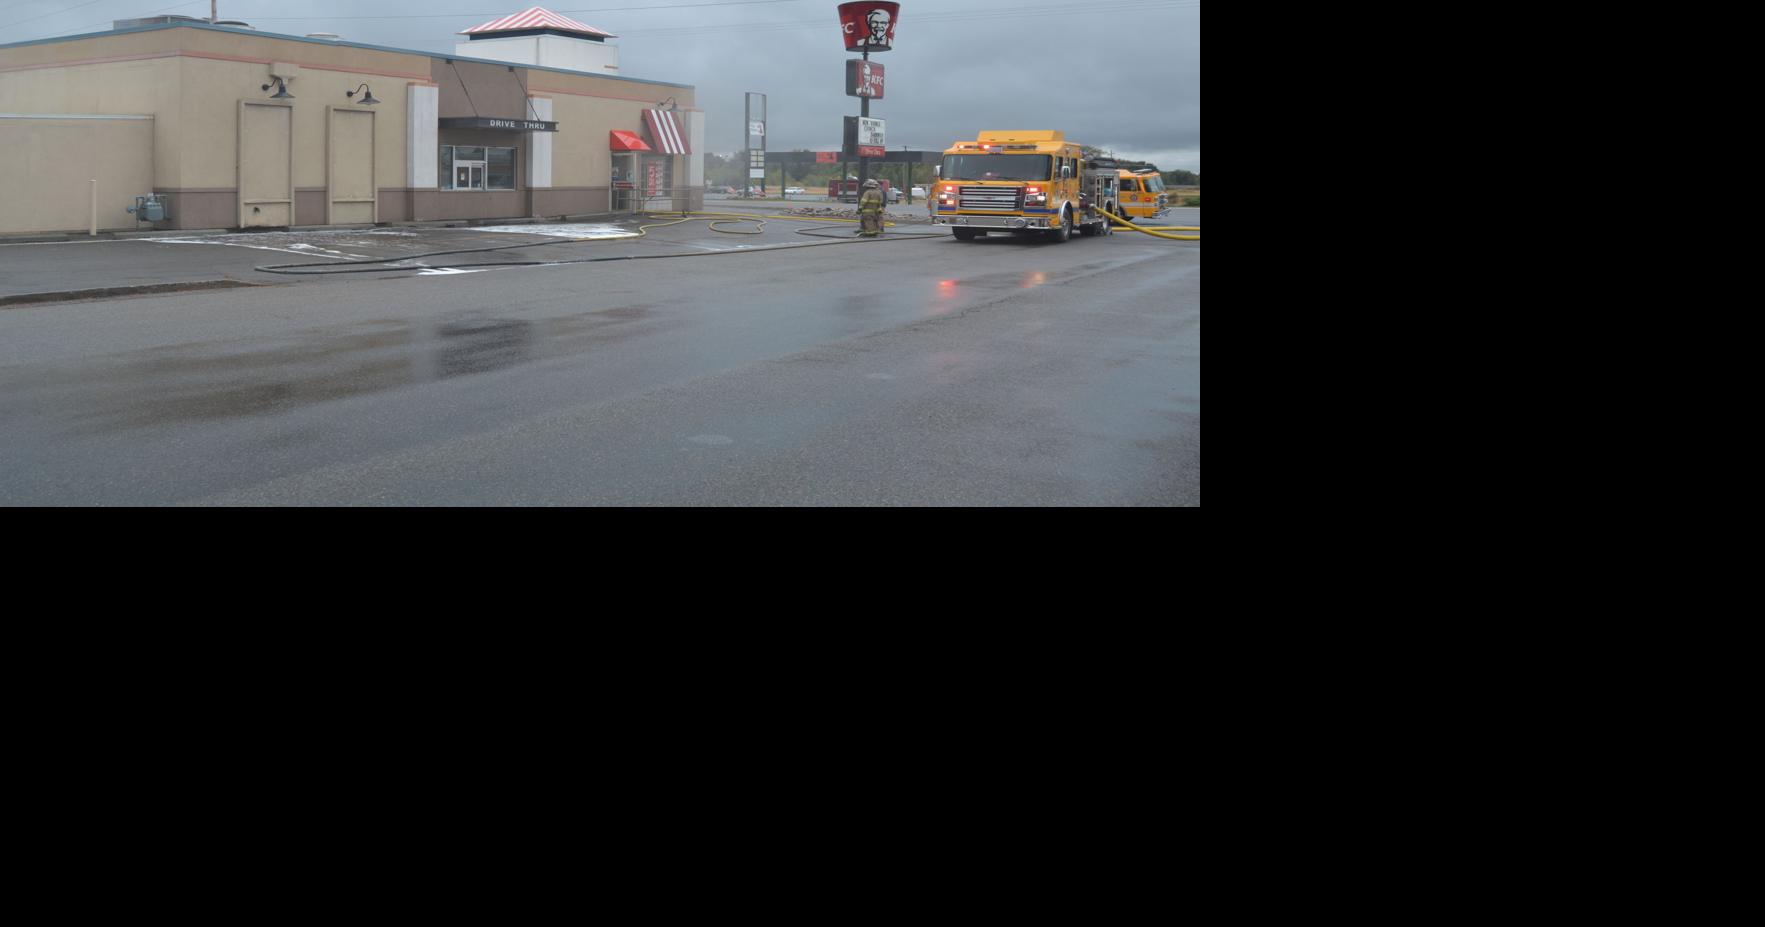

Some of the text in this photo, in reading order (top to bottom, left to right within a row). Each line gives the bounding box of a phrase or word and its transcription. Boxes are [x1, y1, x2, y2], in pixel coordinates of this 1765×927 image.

[871, 74, 884, 86] KFC
[489, 119, 545, 130] DRIVE THRU
